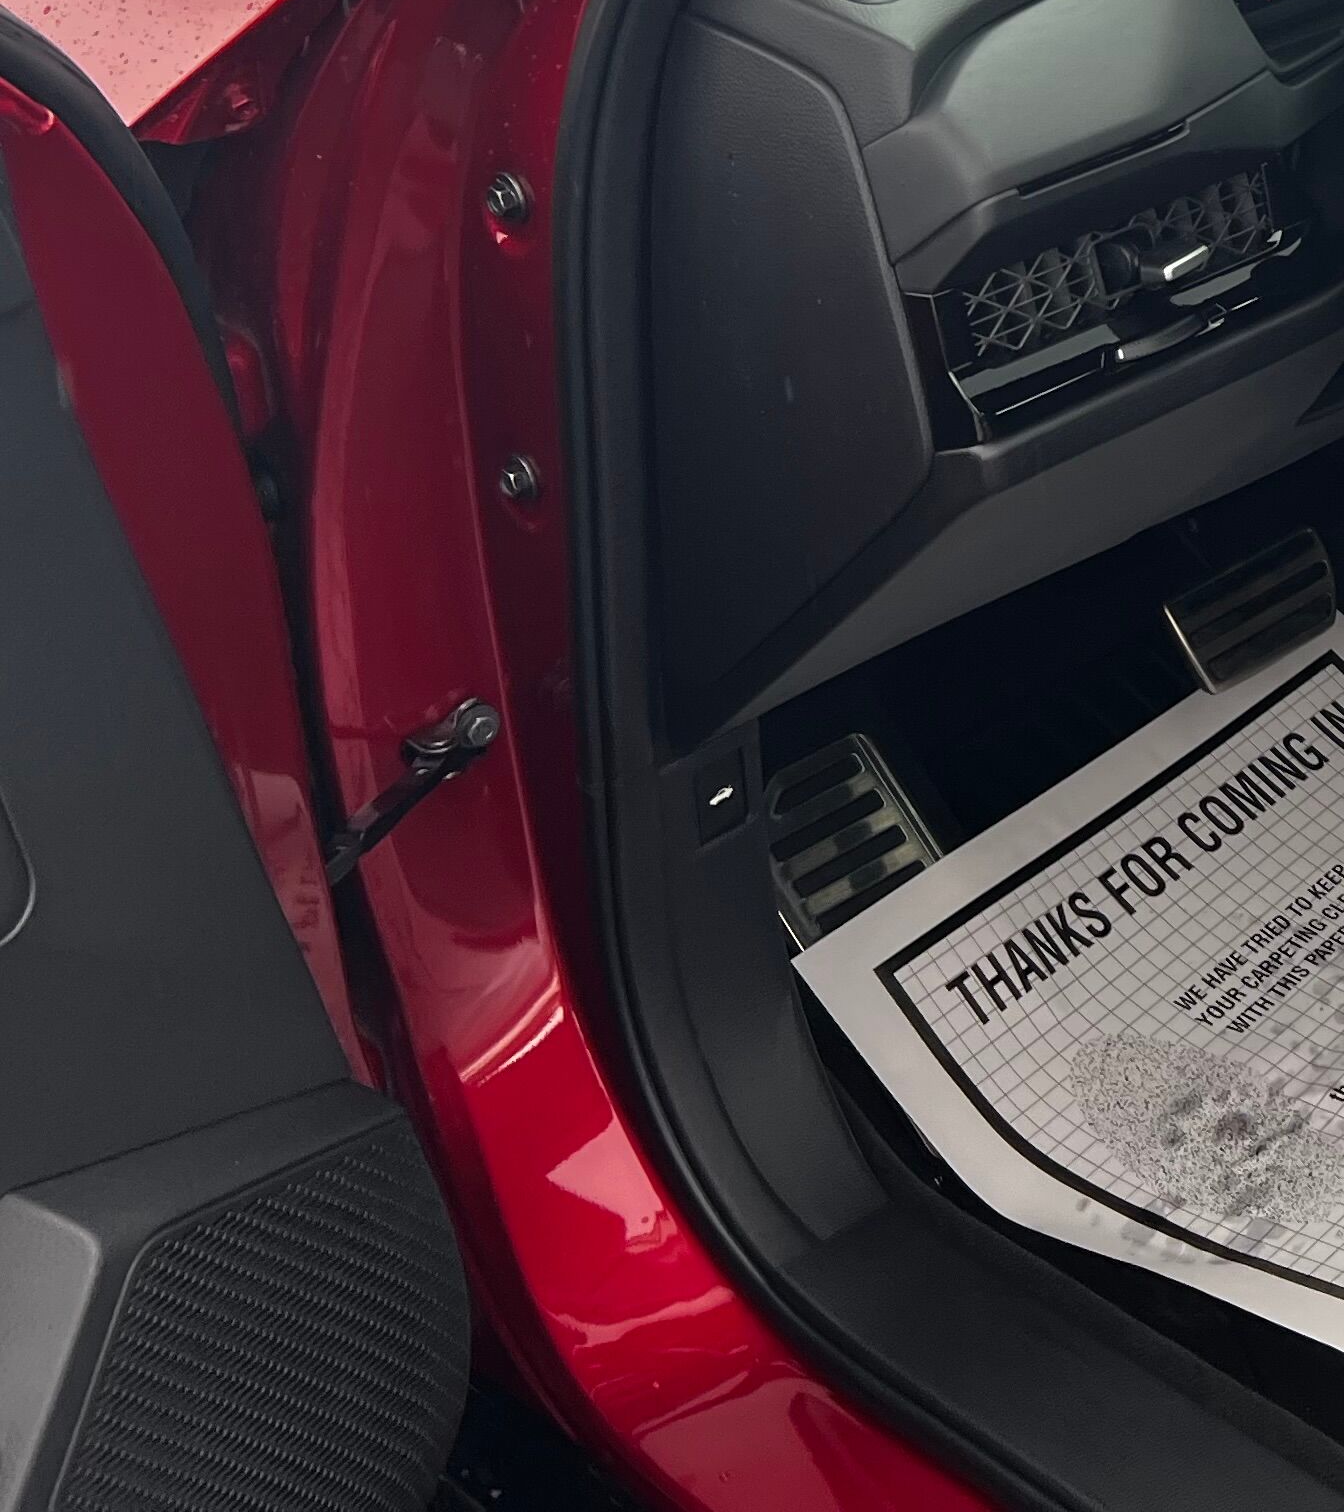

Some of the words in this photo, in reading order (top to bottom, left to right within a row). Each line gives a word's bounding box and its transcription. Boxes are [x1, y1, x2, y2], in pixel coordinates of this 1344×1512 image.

[946, 891, 1112, 1025] THANKS
[1098, 835, 1193, 915] FOR
[1177, 733, 1329, 852] COMING
[1173, 984, 1208, 1012] WE
[1202, 950, 1248, 989] HAVE
[1241, 915, 1290, 954] TRIED
[1285, 896, 1313, 917] TO
[1195, 987, 1247, 1028] YOUR
[1241, 918, 1327, 989] CARPETING
[1226, 996, 1275, 1035] WITH
[1267, 965, 1310, 998] THIS
